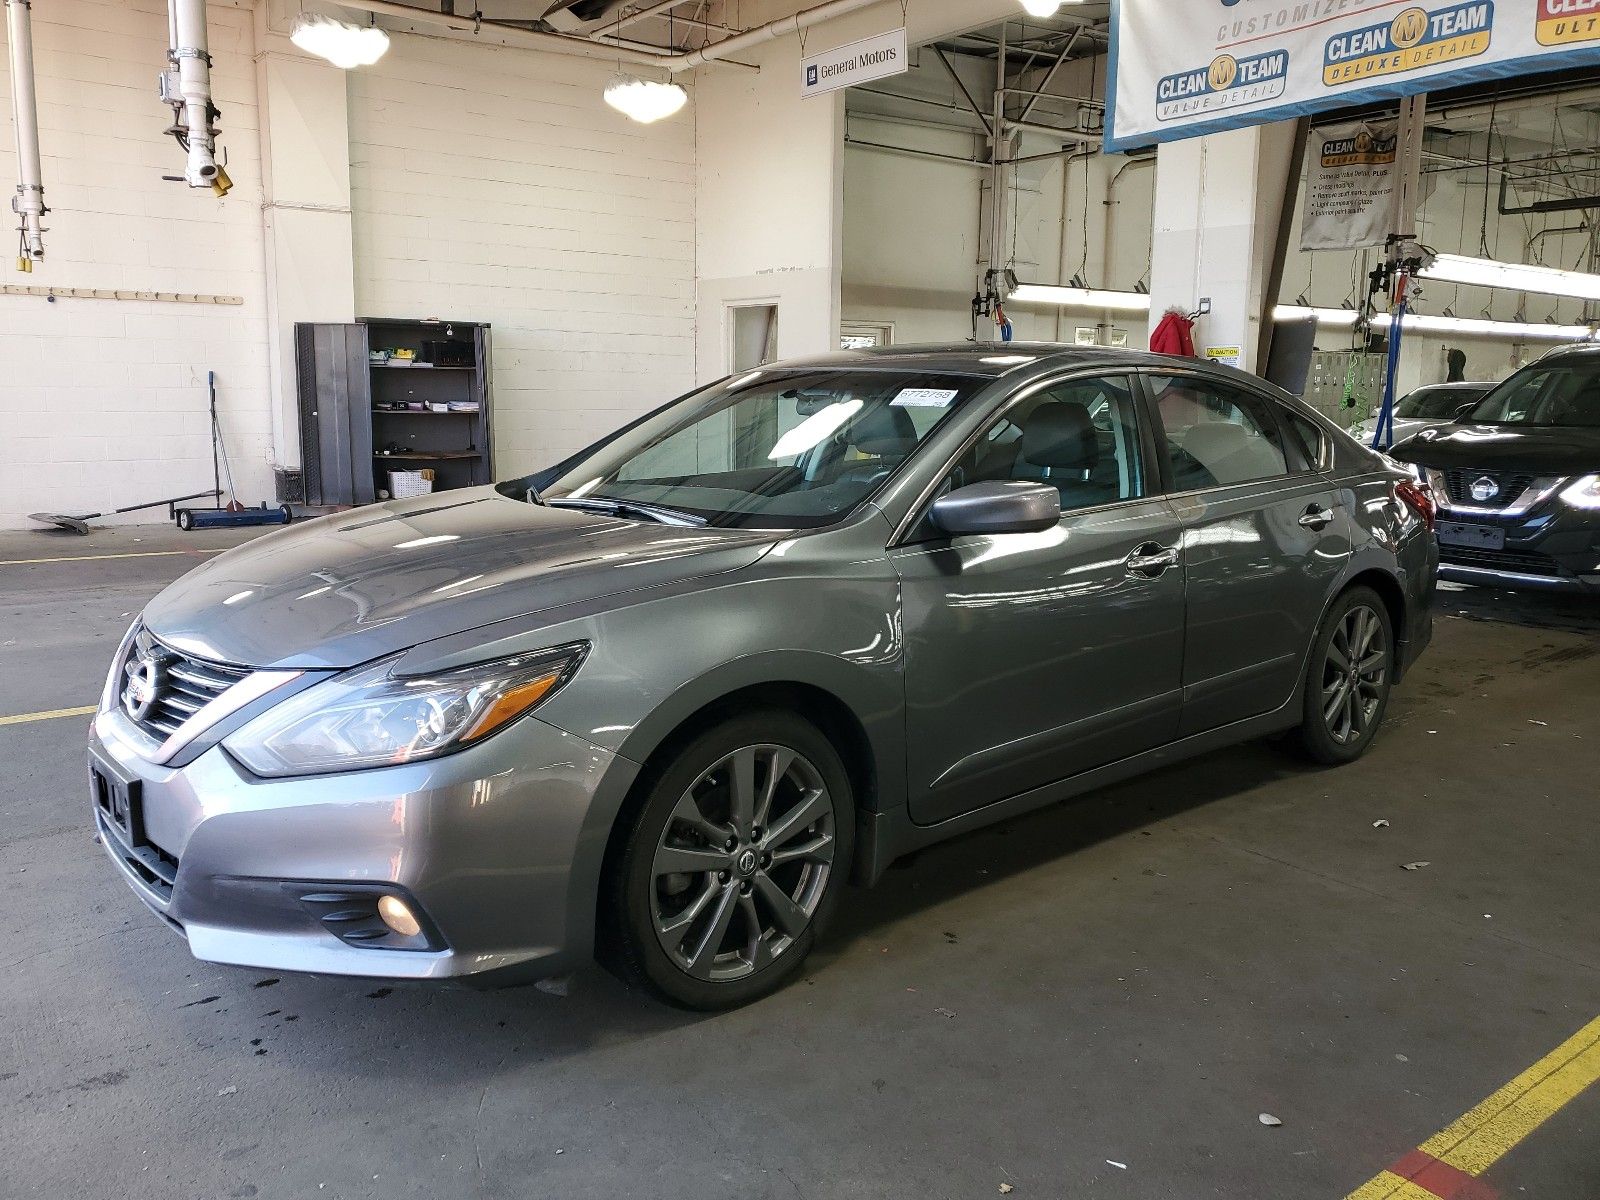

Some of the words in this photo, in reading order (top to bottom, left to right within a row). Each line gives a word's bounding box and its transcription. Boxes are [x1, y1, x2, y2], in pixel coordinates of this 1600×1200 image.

[1328, 27, 1388, 60] CLEAN
[1431, 4, 1488, 38] TEAM
[821, 57, 857, 78] General
[859, 47, 897, 67] Motors
[1159, 71, 1207, 99] CLEAN
[1239, 54, 1284, 82] TEAM
[1331, 55, 1401, 80] DELUXE
[1413, 38, 1477, 63] DETAIL
[1163, 98, 1210, 116] VALUE
[1221, 84, 1277, 104] DETAIL
[1323, 141, 1355, 154] CLEAN
